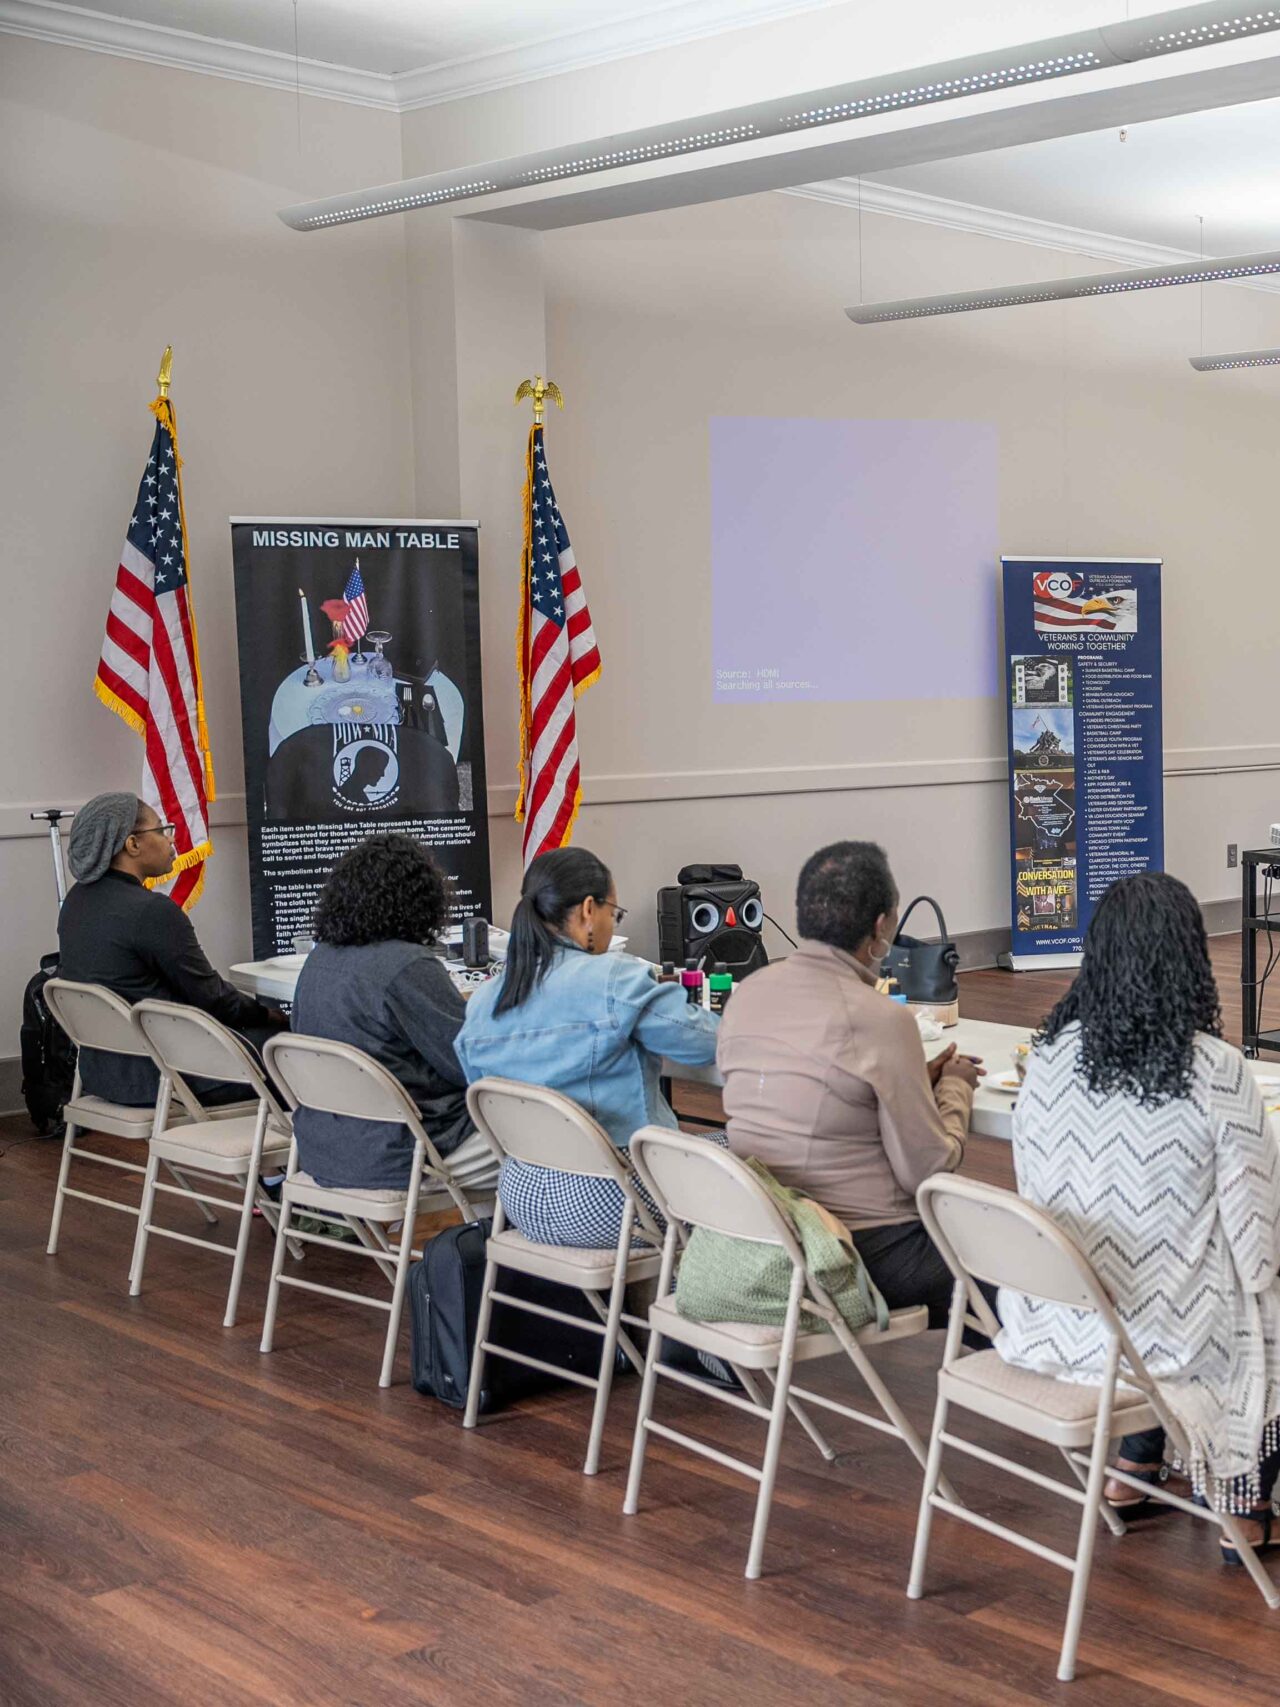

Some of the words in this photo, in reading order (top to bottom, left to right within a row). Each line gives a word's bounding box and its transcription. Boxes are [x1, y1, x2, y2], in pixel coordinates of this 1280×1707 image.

[253, 531, 339, 547] MISSING
[345, 532, 390, 548] MAN
[396, 533, 460, 549] TABLE
[716, 670, 751, 679] Source:
[757, 668, 779, 678] HDMI
[716, 681, 760, 691] Searching
[763, 679, 773, 689] all
[332, 798, 342, 808] YOU
[368, 797, 398, 811] FORGOTTEN
[277, 868, 313, 877] symbolism
[1019, 870, 1074, 880] CONVERSATION
[1026, 886, 1047, 895] WITH
[1048, 886, 1052, 894] A
[1053, 886, 1067, 894] VET
[1036, 937, 1080, 945] WWW.VCOF.ORG
